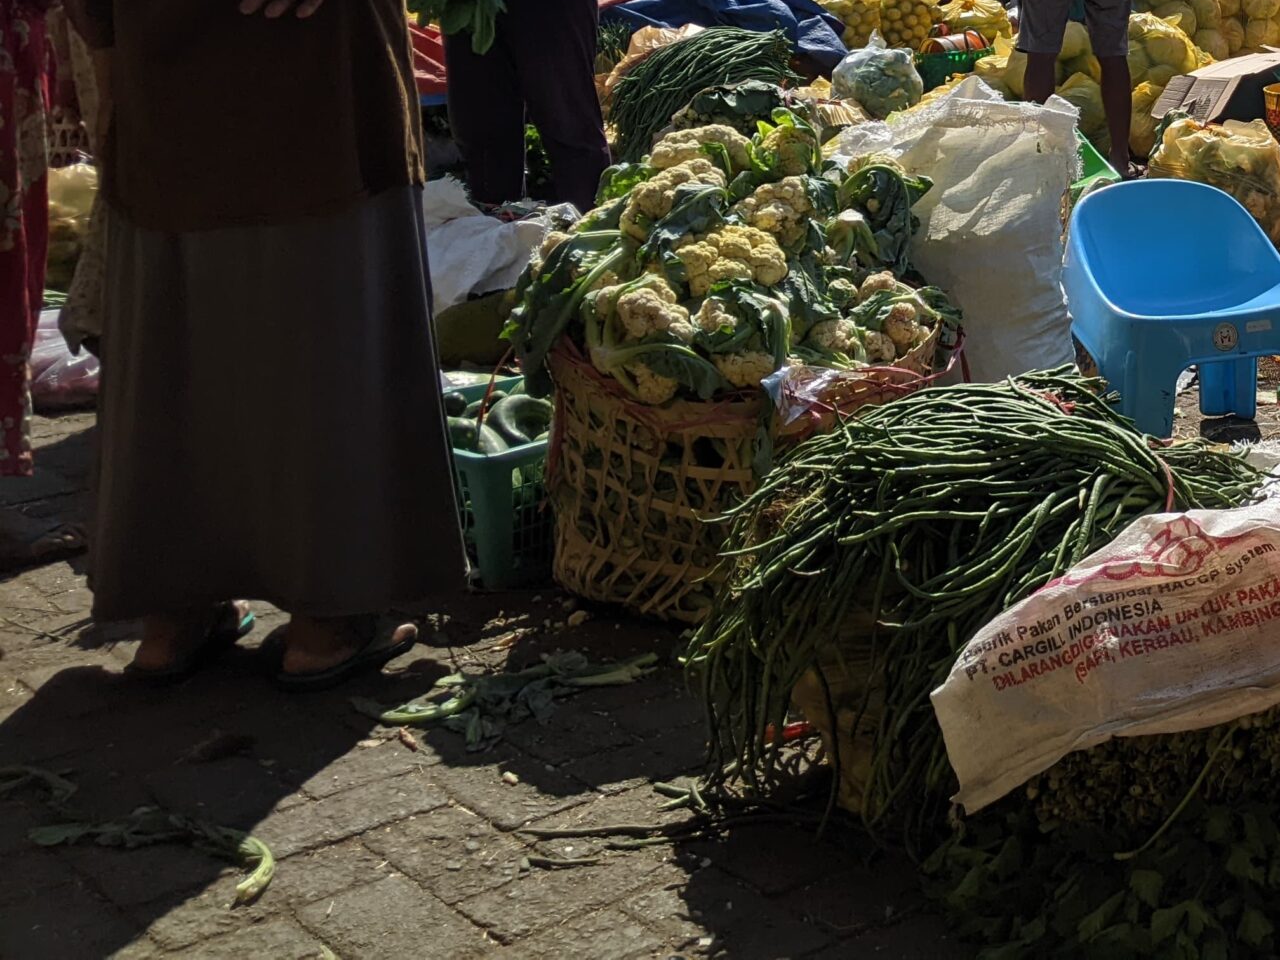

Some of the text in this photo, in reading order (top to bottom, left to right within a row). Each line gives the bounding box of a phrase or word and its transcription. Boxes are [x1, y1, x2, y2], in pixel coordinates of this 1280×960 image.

[1016, 614, 1060, 641] Pakan
[1063, 586, 1151, 620] Berstandar
[1226, 542, 1276, 576] System
[1175, 593, 1235, 626] UNTUK
[965, 597, 1163, 681] PT. CARGILL INDONESIA
